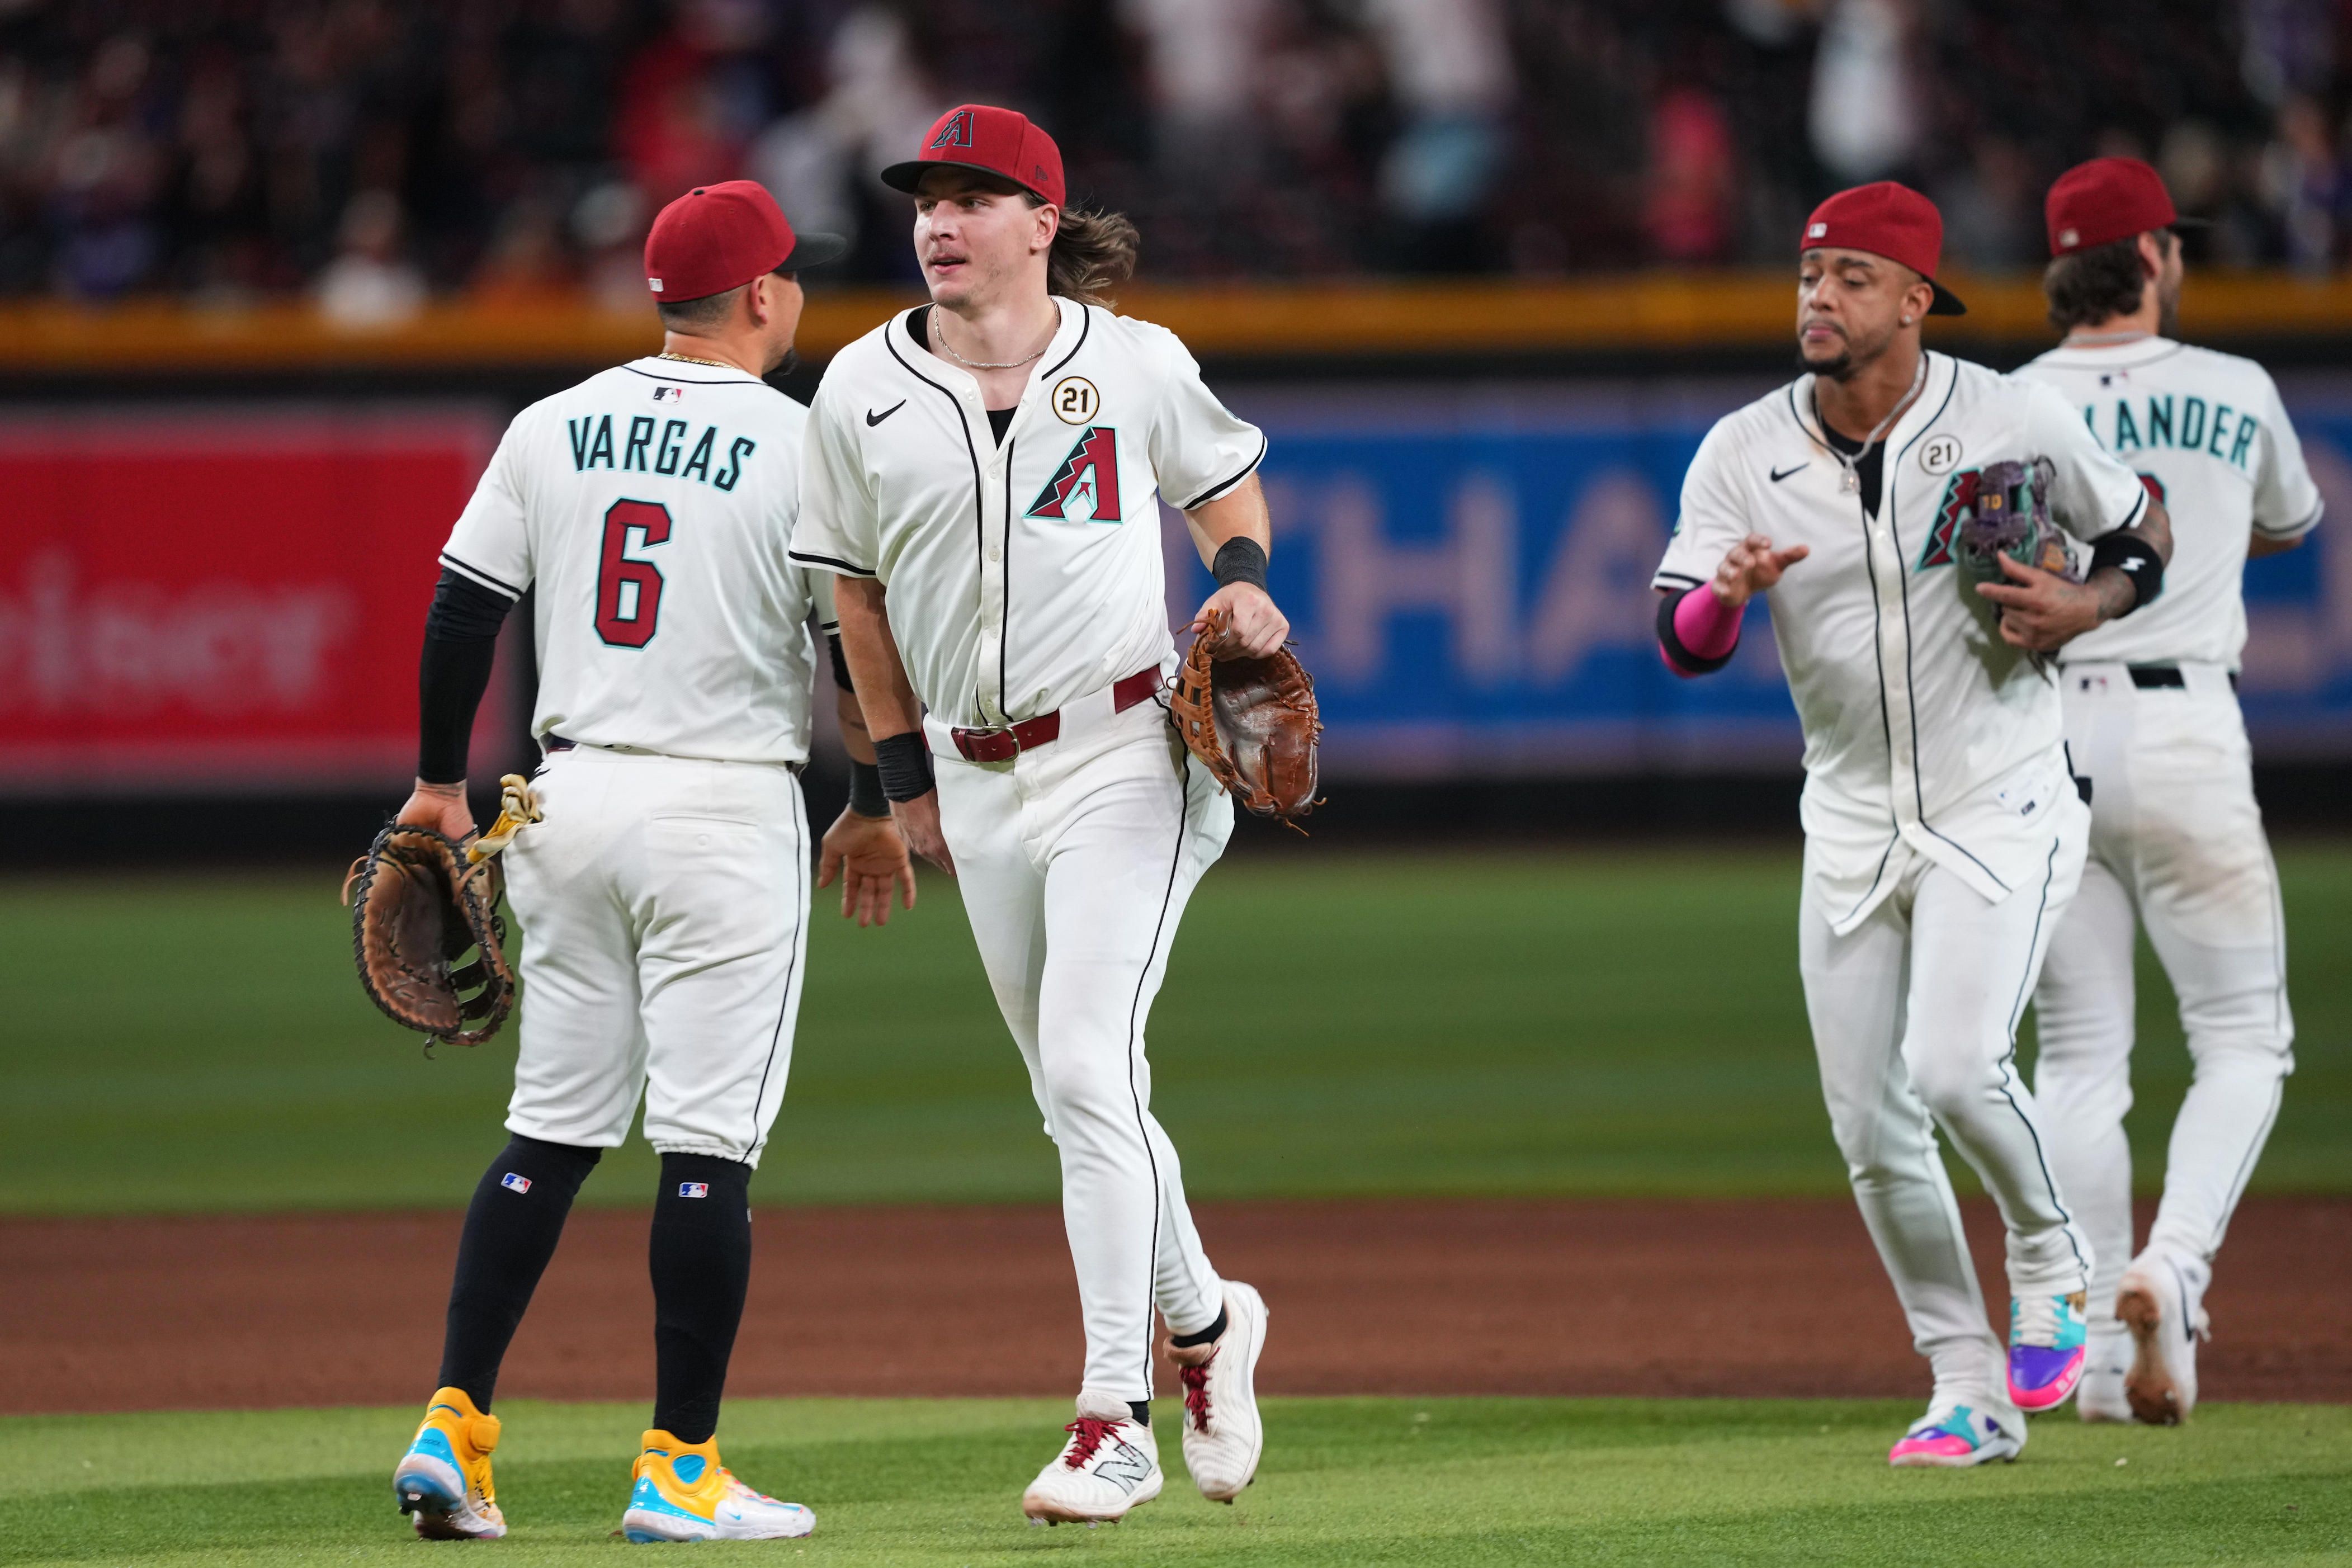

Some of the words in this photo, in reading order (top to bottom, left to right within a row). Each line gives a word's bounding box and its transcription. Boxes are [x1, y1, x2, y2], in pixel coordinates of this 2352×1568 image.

[1062, 386, 1089, 413] 21
[567, 413, 757, 494] VARGAS
[1929, 443, 1951, 465] 21
[593, 496, 672, 652] 6
